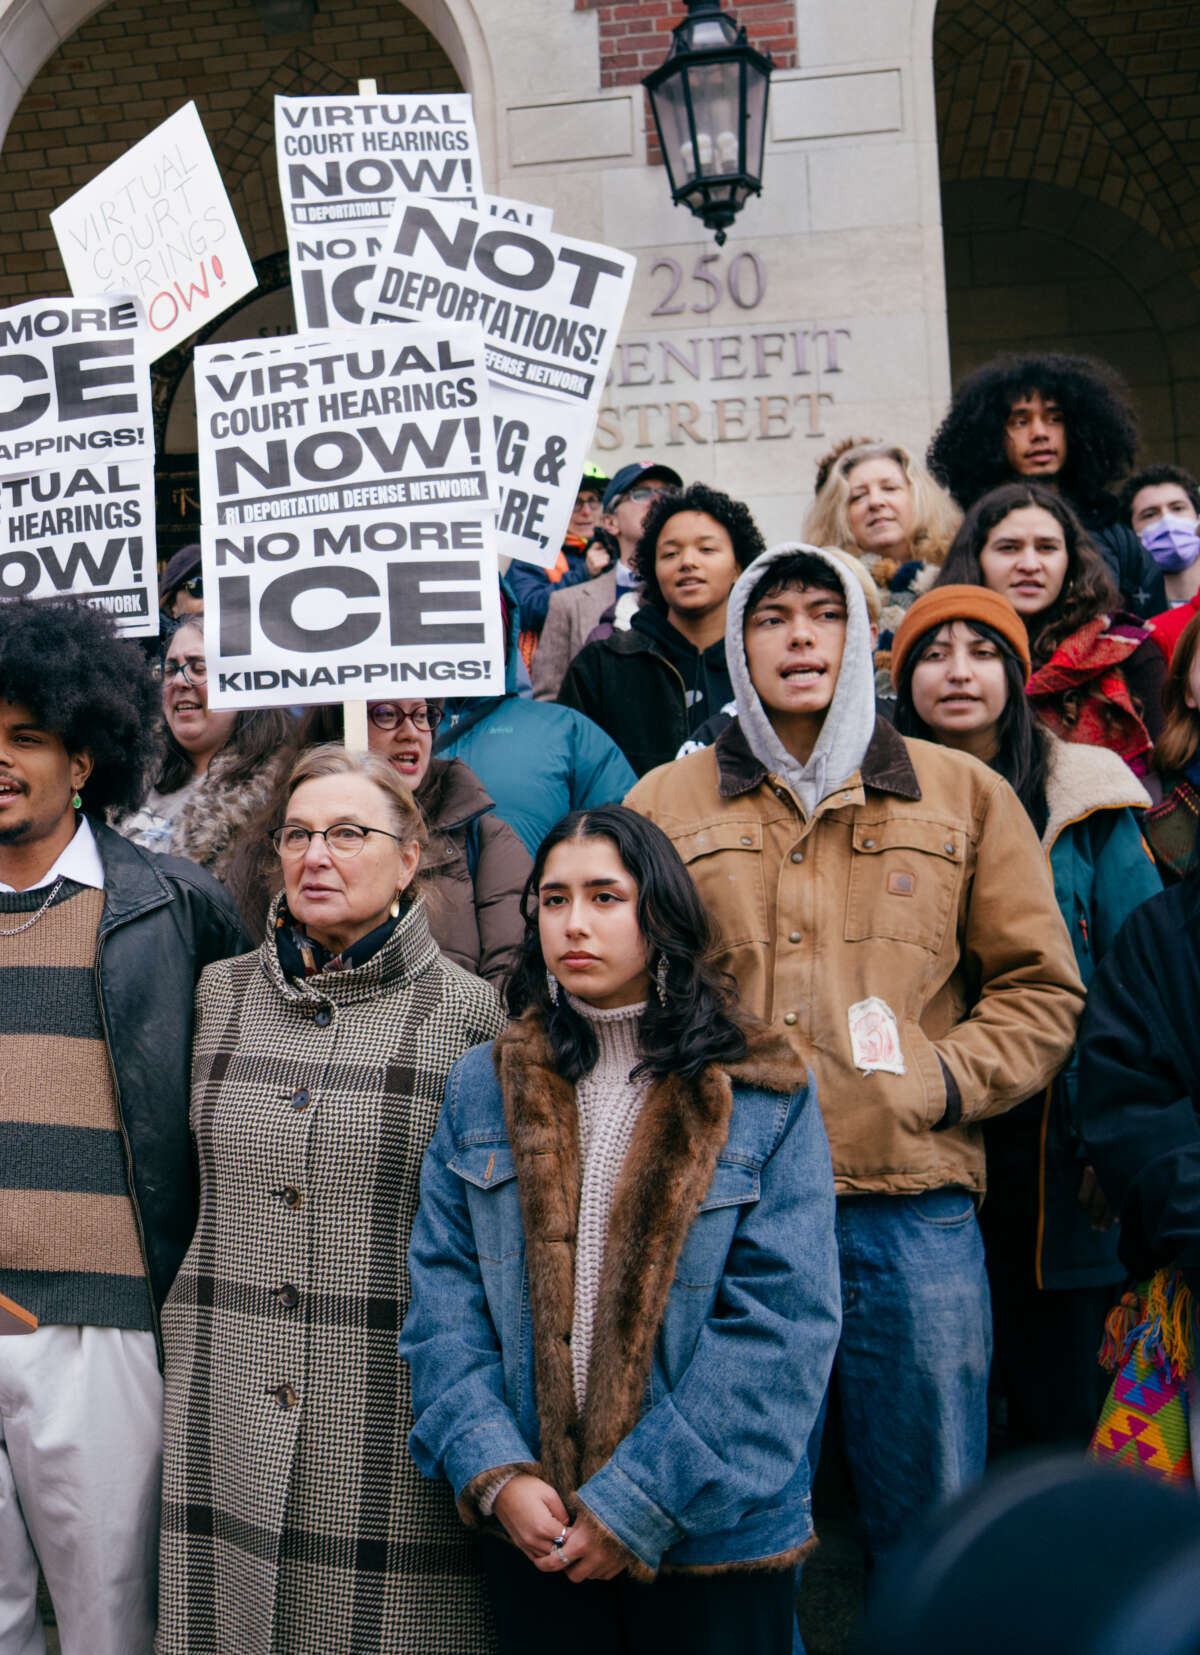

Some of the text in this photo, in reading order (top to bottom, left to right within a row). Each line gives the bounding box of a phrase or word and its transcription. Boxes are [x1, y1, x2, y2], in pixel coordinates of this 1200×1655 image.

[282, 104, 467, 129] VIRTUAL
[284, 130, 469, 157] COURT HEARINGS
[68, 144, 199, 252] VIRTUAL
[288, 158, 473, 198] NOW!
[93, 176, 193, 280] COURT
[308, 202, 379, 221] DEPORTATION
[104, 206, 226, 297] RINGS
[296, 238, 357, 262] NO
[393, 205, 625, 310] NOT
[149, 255, 226, 332] OW!
[301, 264, 376, 329] IC
[651, 251, 767, 317] 250
[378, 266, 607, 366] DEPORTATIONS!
[205, 340, 475, 402] VIRTUAL
[485, 350, 589, 395] FENSE NETWORK
[210, 377, 479, 440] COURT HEARINGS
[595, 392, 835, 451] STREET
[215, 416, 482, 497] NOW!
[533, 435, 568, 488] &
[8, 500, 142, 543] HEARINGS
[225, 477, 481, 525] RI DEPORTATION DEFENSE NETWORK
[215, 521, 485, 566] NO MORE
[218, 560, 486, 657] ICE
[218, 660, 493, 693] KIDNAPPINGS!
